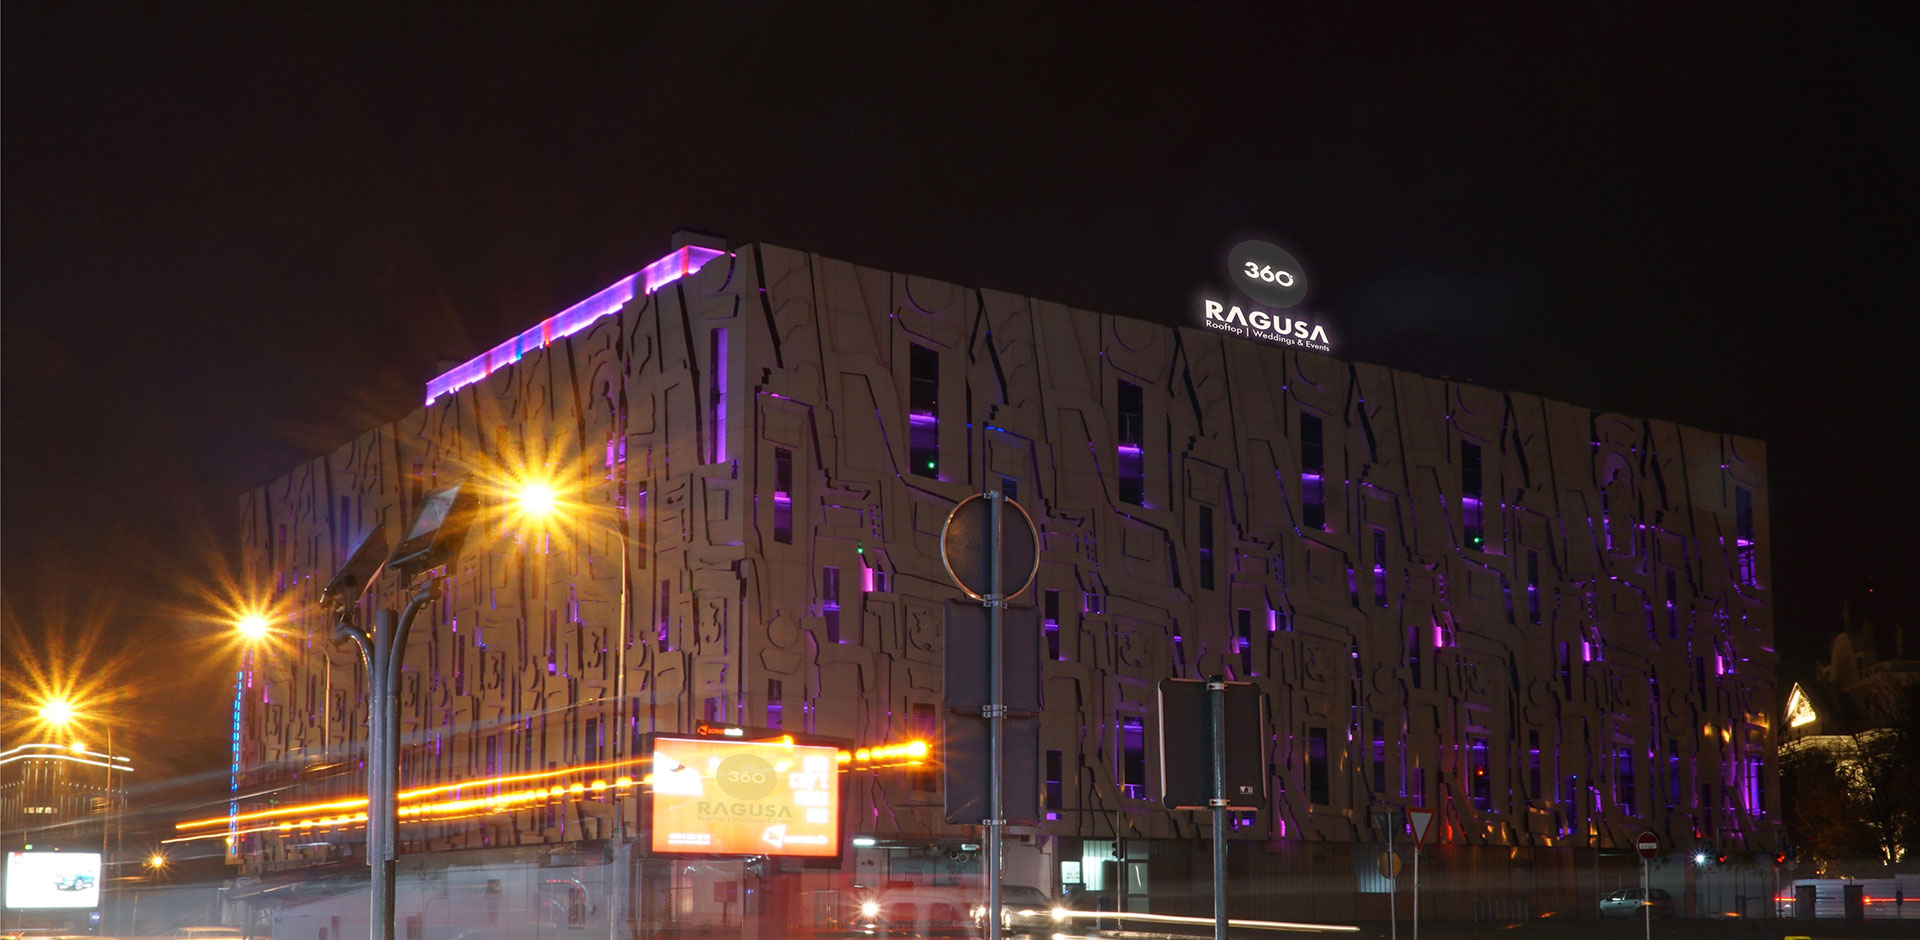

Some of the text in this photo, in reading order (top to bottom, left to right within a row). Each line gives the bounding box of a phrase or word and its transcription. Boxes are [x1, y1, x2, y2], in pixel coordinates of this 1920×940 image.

[1205, 299, 1330, 345] RAGUSA
[1206, 319, 1243, 335] Rooftop
[1252, 329, 1296, 346] Weddings
[1297, 338, 1304, 346] &
[1305, 340, 1330, 352] Events
[697, 801, 793, 818] RAGUSA
